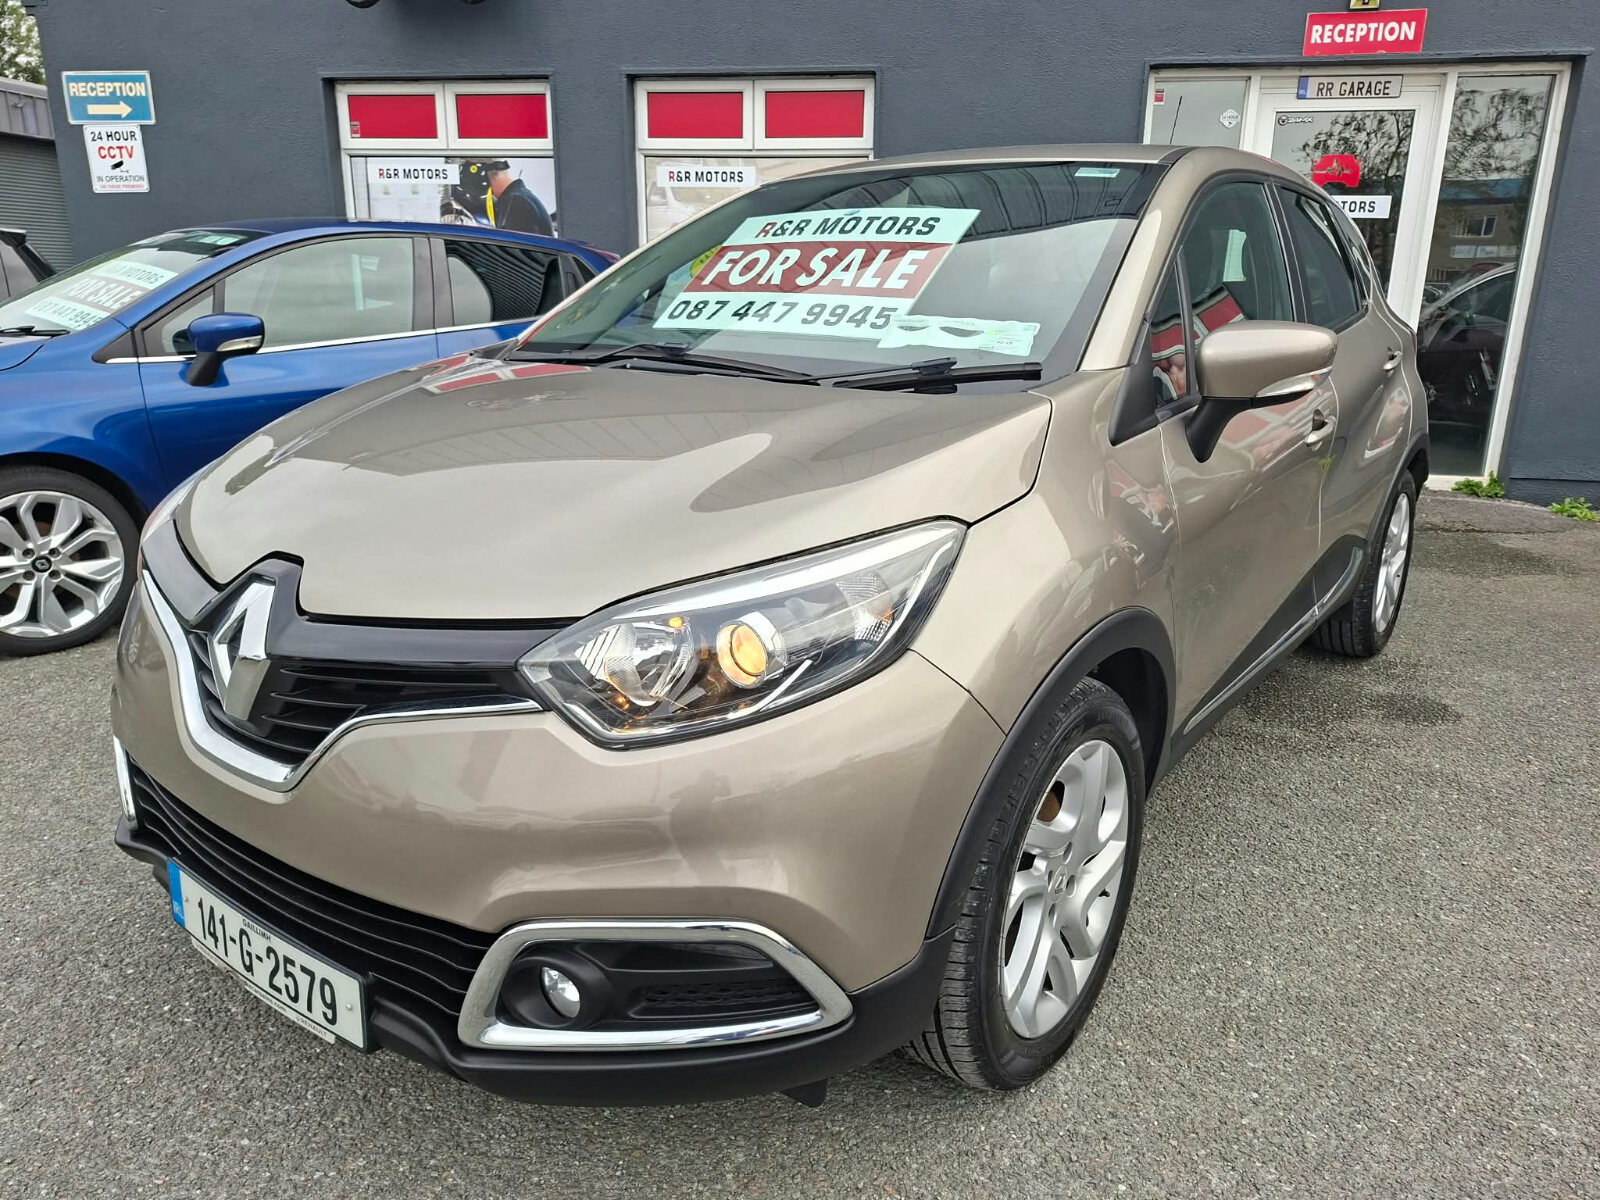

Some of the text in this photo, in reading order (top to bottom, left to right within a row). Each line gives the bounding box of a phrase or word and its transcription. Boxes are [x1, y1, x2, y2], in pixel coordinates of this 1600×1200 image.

[1310, 21, 1417, 44] RECEPTION
[68, 82, 147, 97] RECEPTION
[1316, 81, 1392, 97] RR GARAGE
[90, 131, 137, 142] 24 HOUR
[97, 145, 135, 159] CCTV
[105, 175, 145, 183] OPERATION
[378, 168, 449, 180] R&R MOTORS
[668, 170, 744, 183] R&R MOTORS
[1336, 200, 1376, 213] TORS
[755, 215, 941, 239] R&R MOTORS
[701, 248, 929, 290] FOR SALE
[667, 300, 898, 331] 087 447 9945
[198, 896, 338, 1026] 141-G-2579
